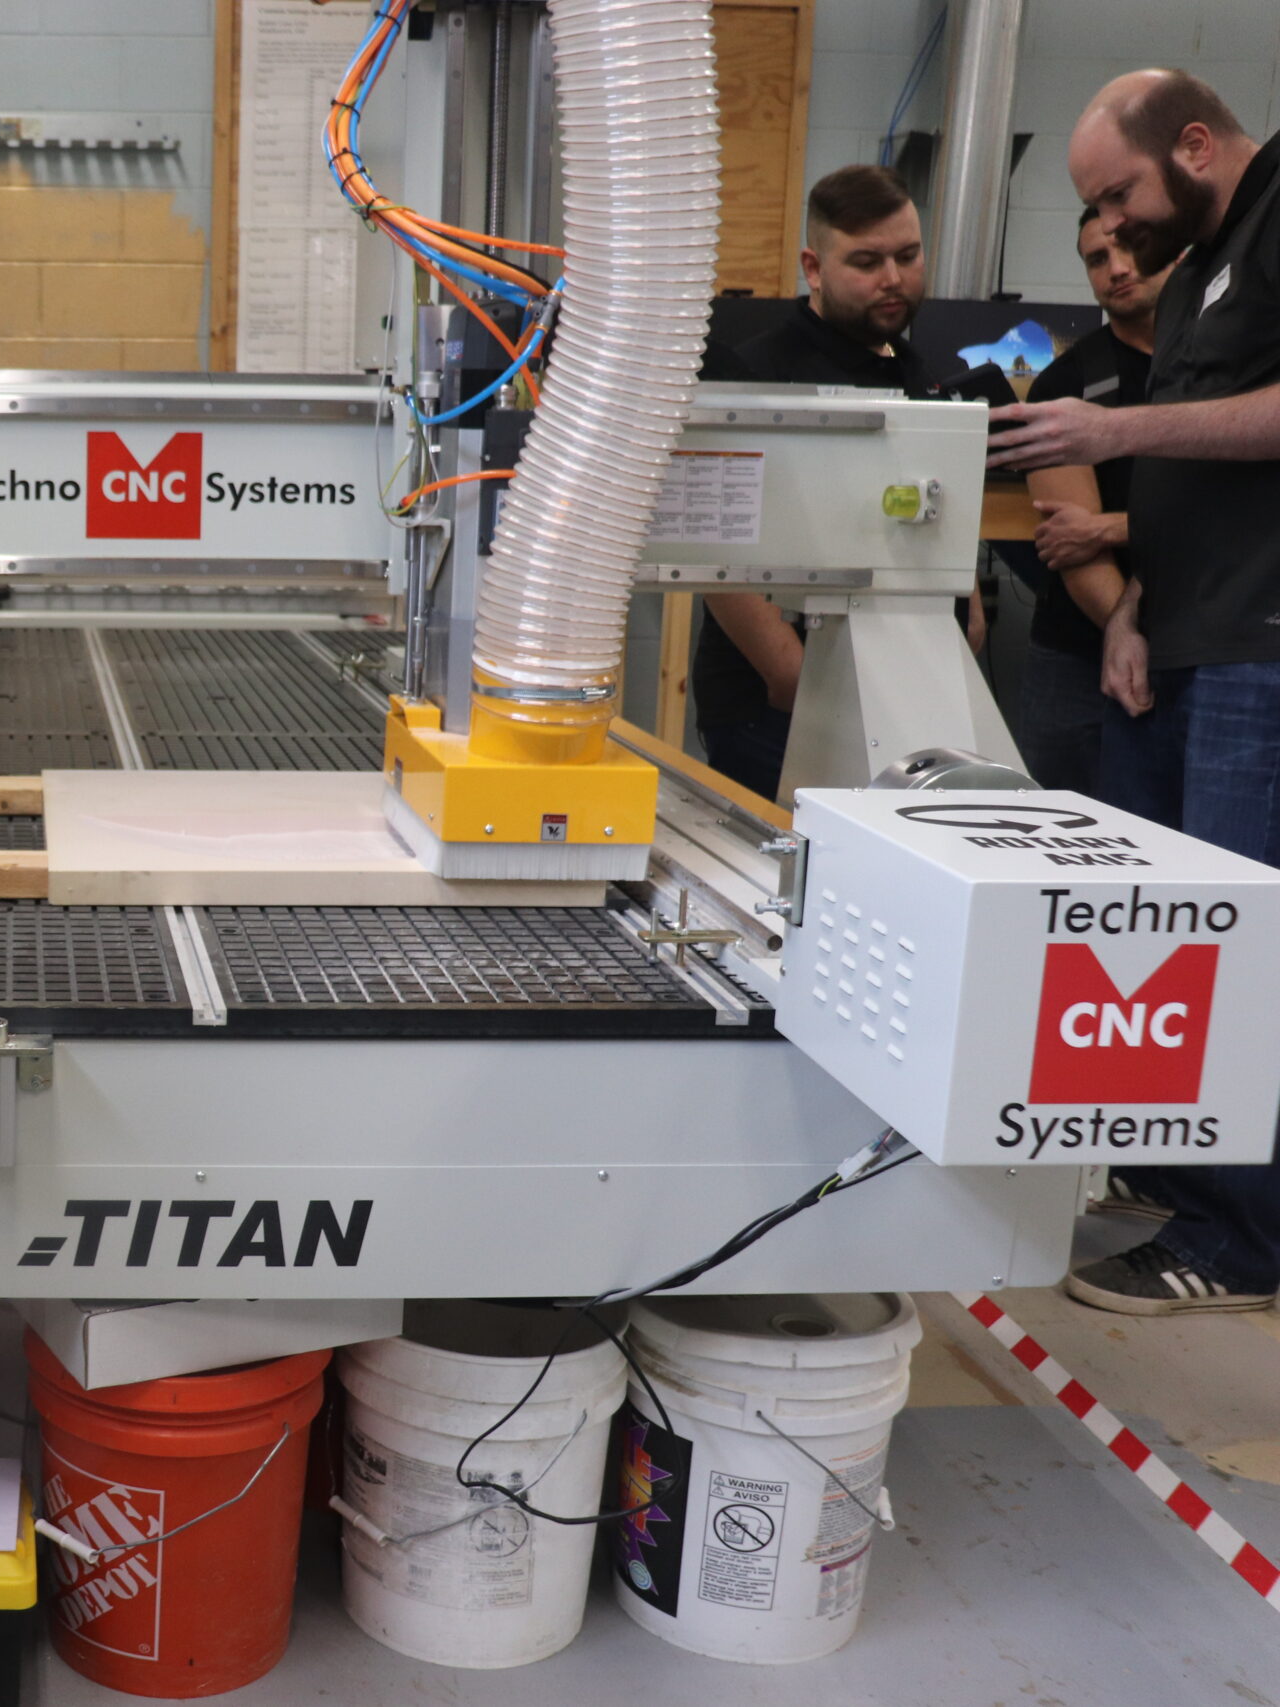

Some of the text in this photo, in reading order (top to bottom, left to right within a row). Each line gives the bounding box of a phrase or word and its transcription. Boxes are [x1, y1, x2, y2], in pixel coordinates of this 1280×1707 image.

[101, 469, 186, 503] CNC
[206, 472, 356, 511] Systems
[962, 836, 1141, 849] ROTARY
[1042, 853, 1153, 866] AXIS
[1041, 885, 1238, 935] Techno
[1059, 1001, 1188, 1049] CNC
[996, 1102, 1220, 1160] Systems
[64, 1199, 373, 1267] TITAN
[43, 1473, 73, 1518] HE
[728, 1478, 783, 1493] WARNING
[734, 1490, 770, 1503] AVISO
[60, 1553, 157, 1631] DEPOT
